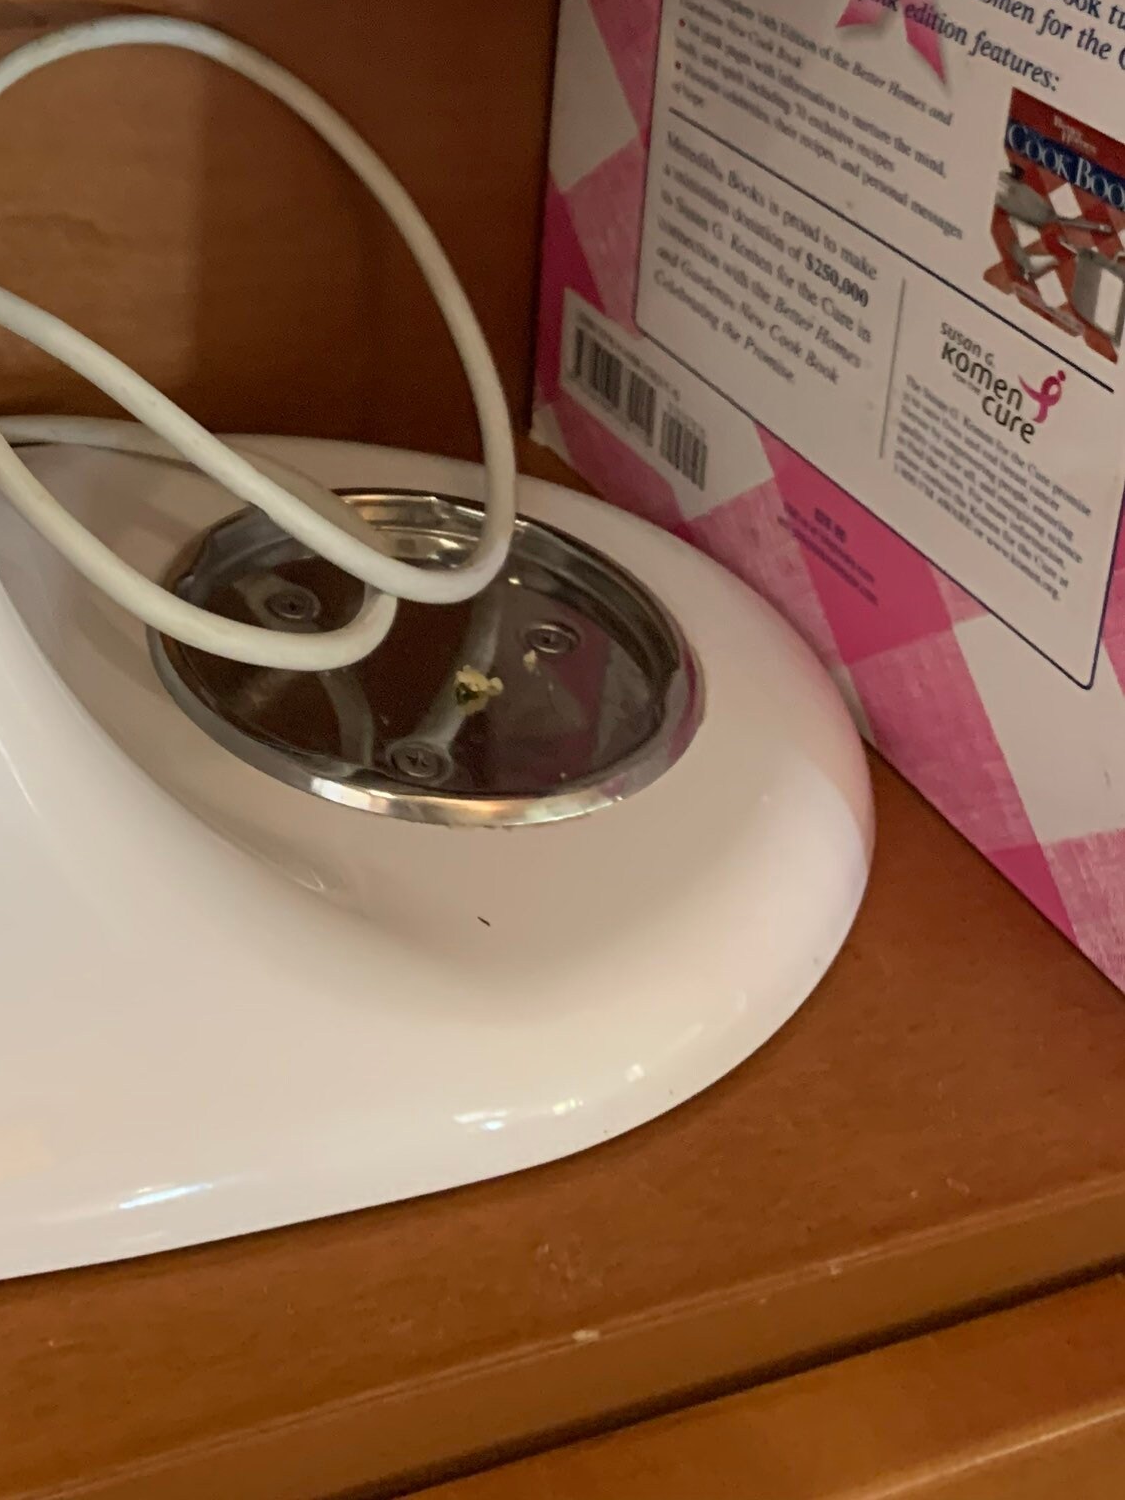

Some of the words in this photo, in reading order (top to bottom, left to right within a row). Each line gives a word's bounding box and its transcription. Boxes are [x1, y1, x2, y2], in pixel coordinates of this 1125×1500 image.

[968, 30, 1059, 90] features:
[1035, 8, 1072, 39] for
[1076, 27, 1112, 60] the
[805, 252, 868, 306] $250,000
[981, 395, 1035, 444] cure
